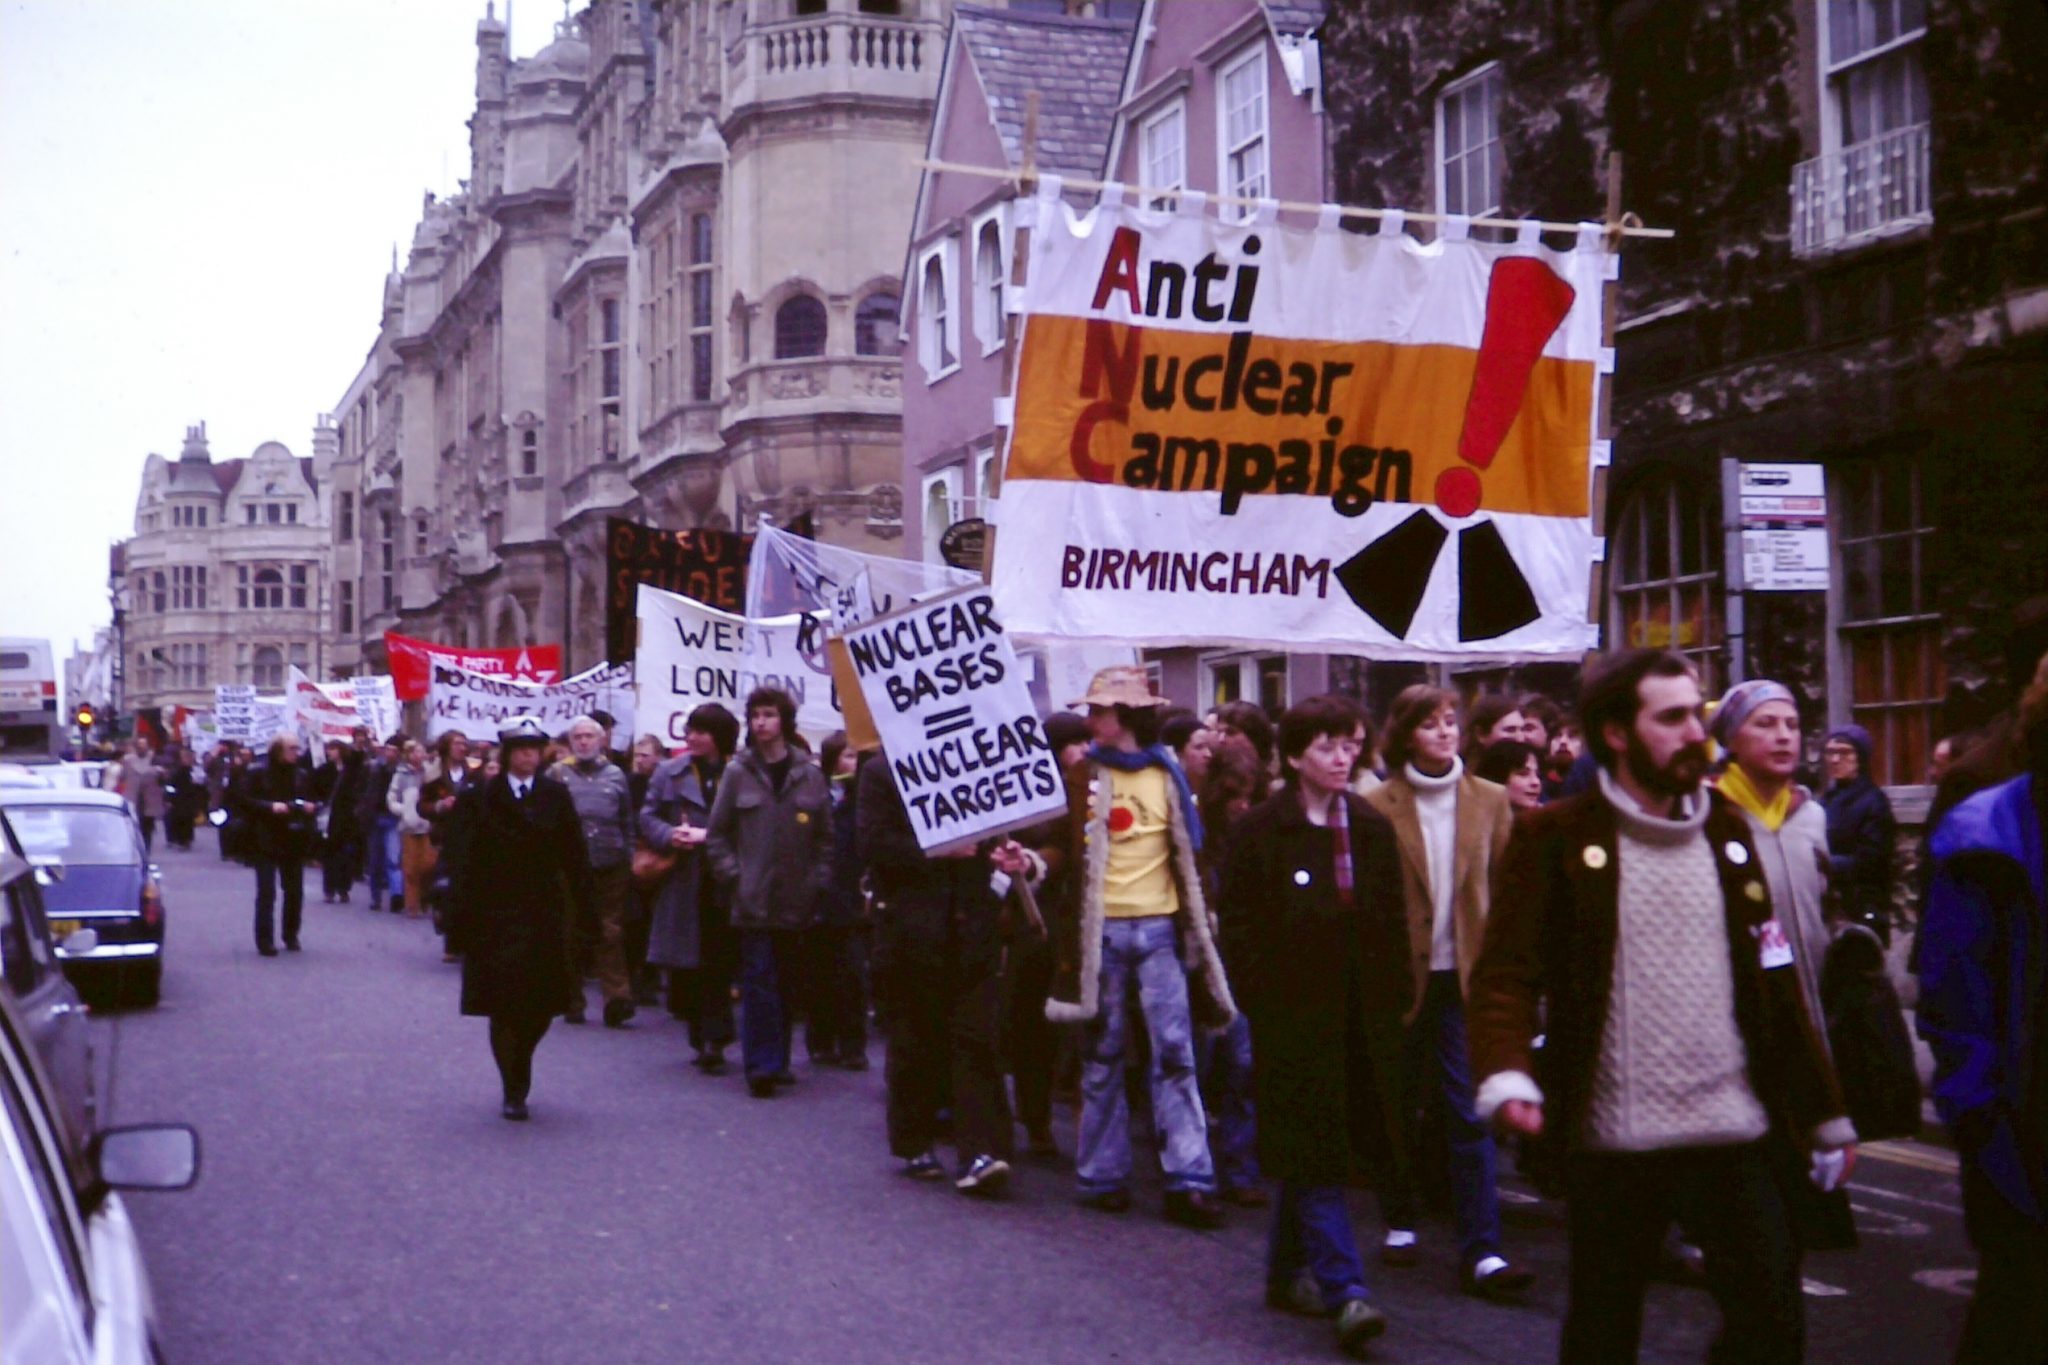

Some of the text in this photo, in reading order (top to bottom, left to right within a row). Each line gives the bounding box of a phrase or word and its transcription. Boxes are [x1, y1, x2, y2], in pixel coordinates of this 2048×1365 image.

[1091, 226, 1261, 322] Anti
[1079, 317, 1353, 416] Nuclear
[1070, 401, 1412, 518] Campaign
[1062, 545, 1331, 598] BIRMINGHAM
[674, 617, 776, 658] WEST
[850, 595, 1003, 677] NUCLEAR
[671, 664, 806, 705] LONDON
[886, 643, 1005, 713] BASES
[895, 716, 1052, 792] NUCLEAR
[910, 759, 1056, 830] TARGETS
